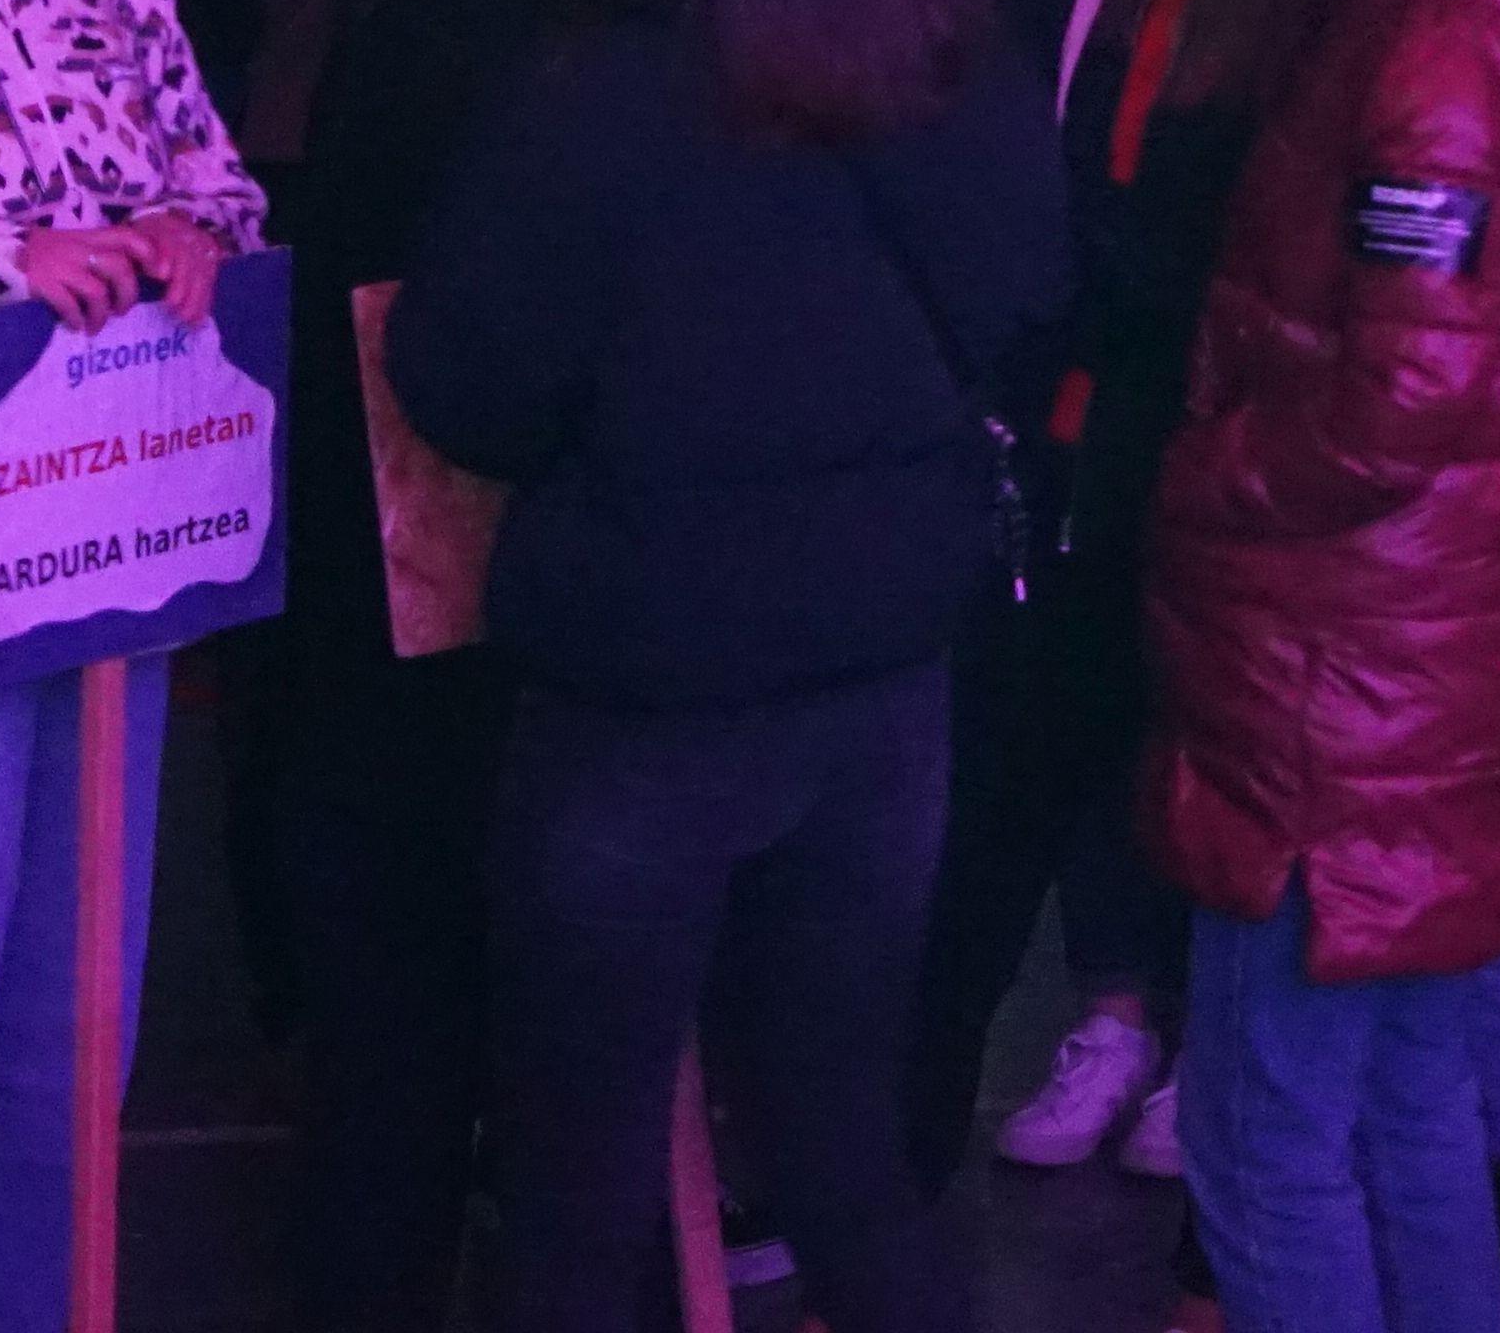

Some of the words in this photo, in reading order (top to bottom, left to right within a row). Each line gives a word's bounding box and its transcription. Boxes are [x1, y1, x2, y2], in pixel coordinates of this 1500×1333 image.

[66, 327, 188, 388] gizonek
[138, 410, 255, 461] lanetan
[135, 506, 251, 558] hartzea
